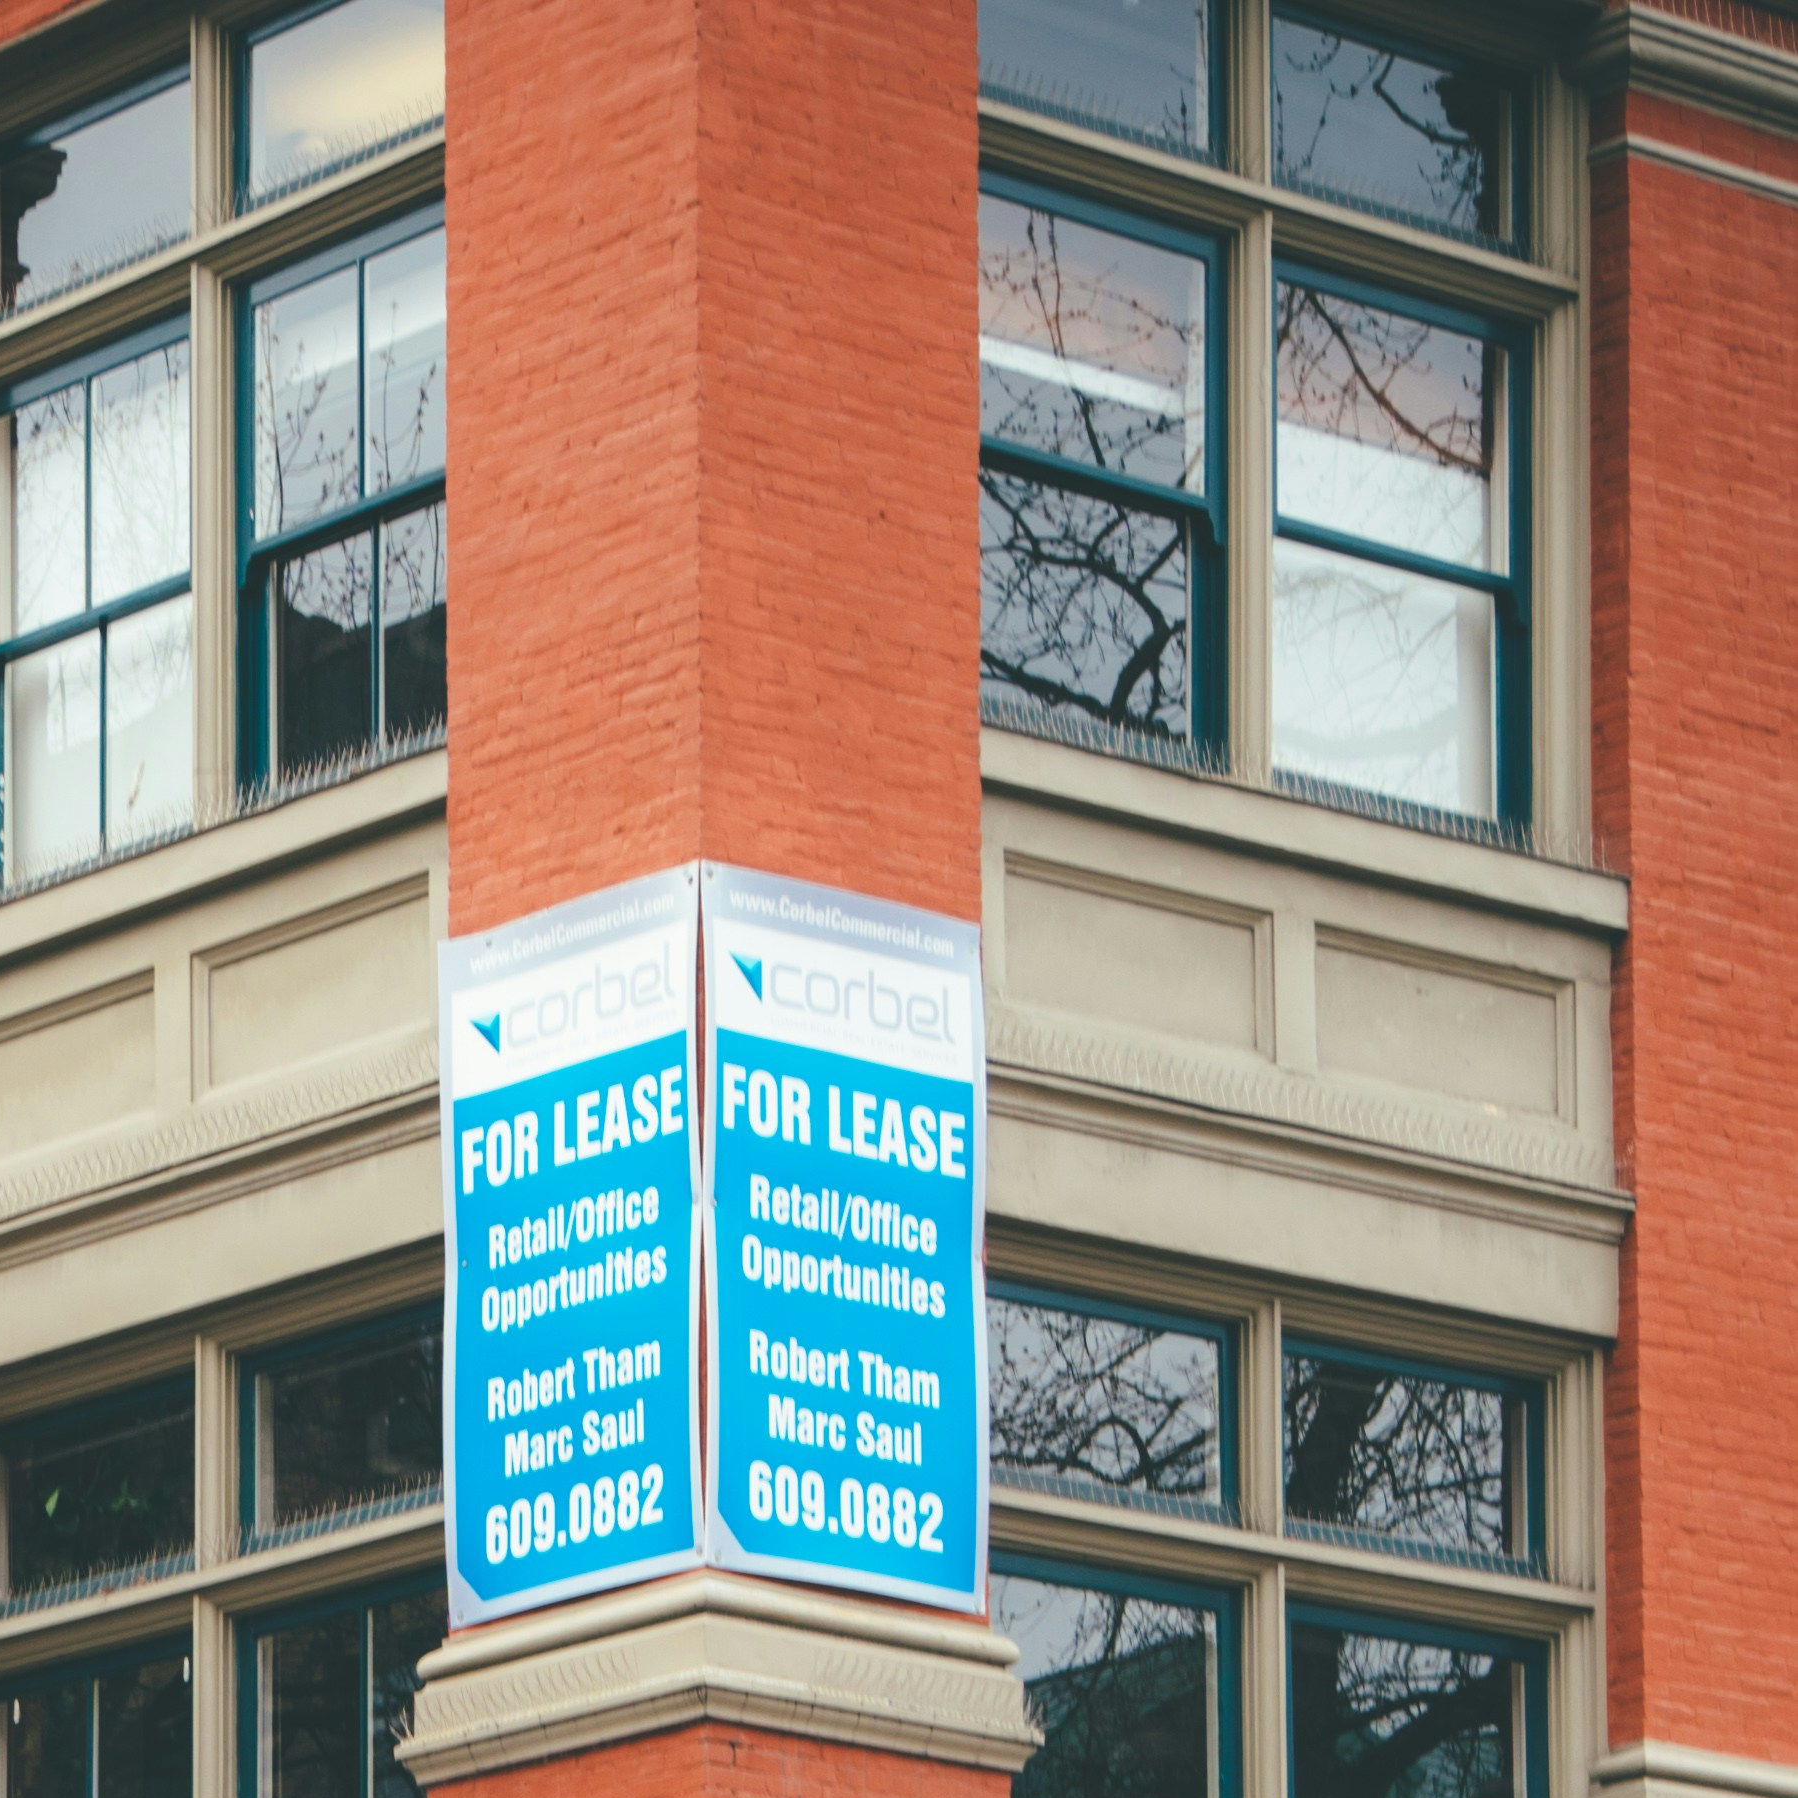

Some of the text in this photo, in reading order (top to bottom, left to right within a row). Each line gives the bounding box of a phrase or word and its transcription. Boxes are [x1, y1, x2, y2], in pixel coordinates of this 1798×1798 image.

[468, 893, 676, 975] www.CorbelCommercial.com
[729, 889, 955, 958] www.CorbelCommercial.com
[505, 939, 677, 1049] corbel
[769, 960, 957, 1046] corbel
[461, 1064, 684, 1195] FOR LEASE
[722, 1061, 967, 1180] FOR LEASE
[488, 1186, 660, 1270] Retail/Office
[749, 1173, 938, 1257] Retail/Office
[481, 1245, 668, 1333] Opportunities
[741, 1234, 947, 1319] Opportunities
[487, 1339, 661, 1422] Robert Tham
[748, 1328, 941, 1409] Robert Tham
[504, 1398, 645, 1478] Marc Saul
[767, 1393, 923, 1467] Marc Saul
[485, 1463, 664, 1565] 609.0882
[748, 1459, 945, 1554] 609.0882
